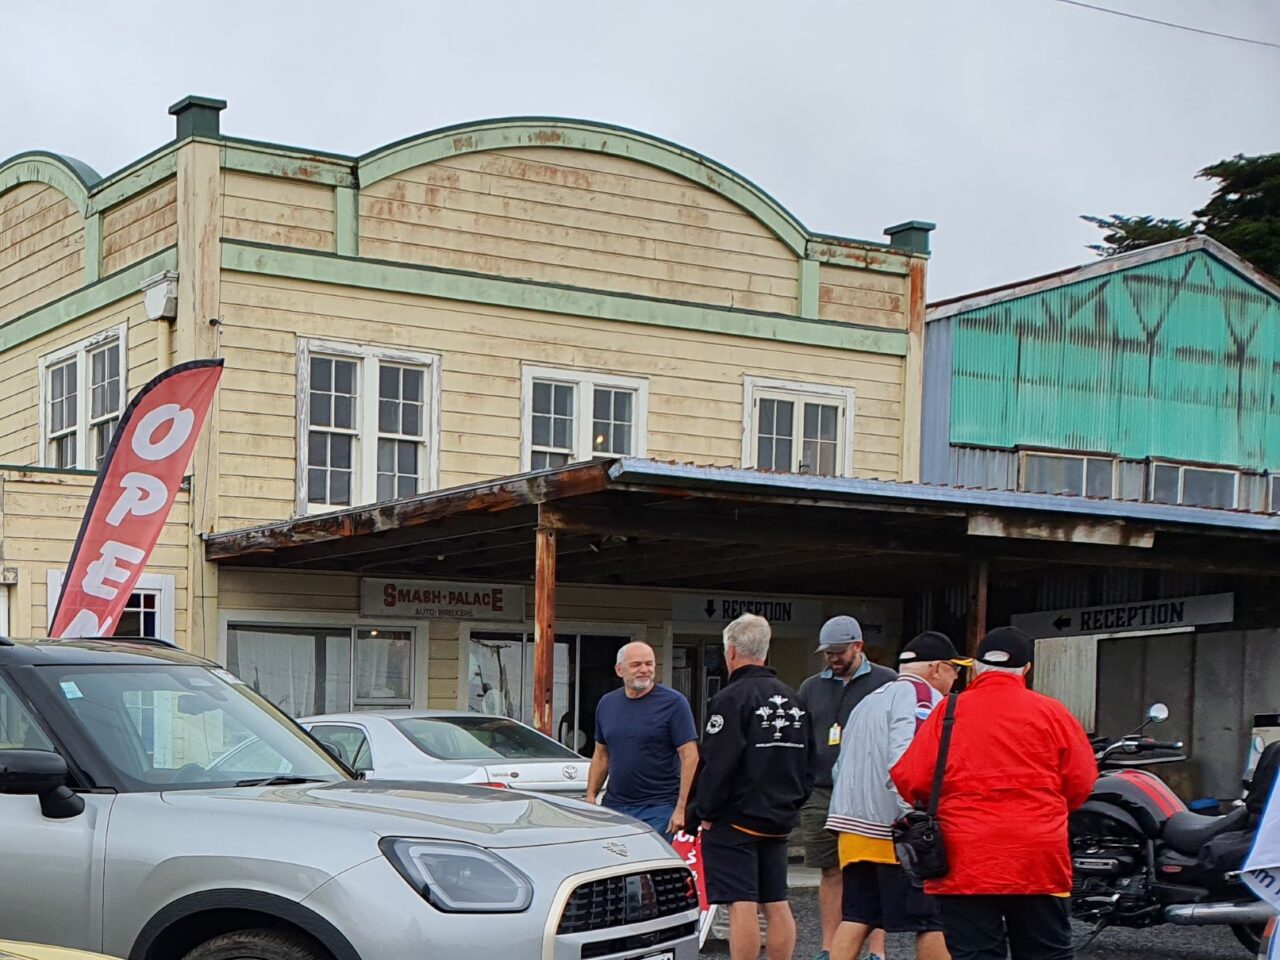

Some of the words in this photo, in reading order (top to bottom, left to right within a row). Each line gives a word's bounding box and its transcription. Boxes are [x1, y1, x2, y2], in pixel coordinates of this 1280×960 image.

[383, 583, 441, 607] SMASH
[448, 588, 504, 612] PALACE
[722, 600, 792, 622] RECEPTION
[1079, 601, 1184, 631] RECEPTION
